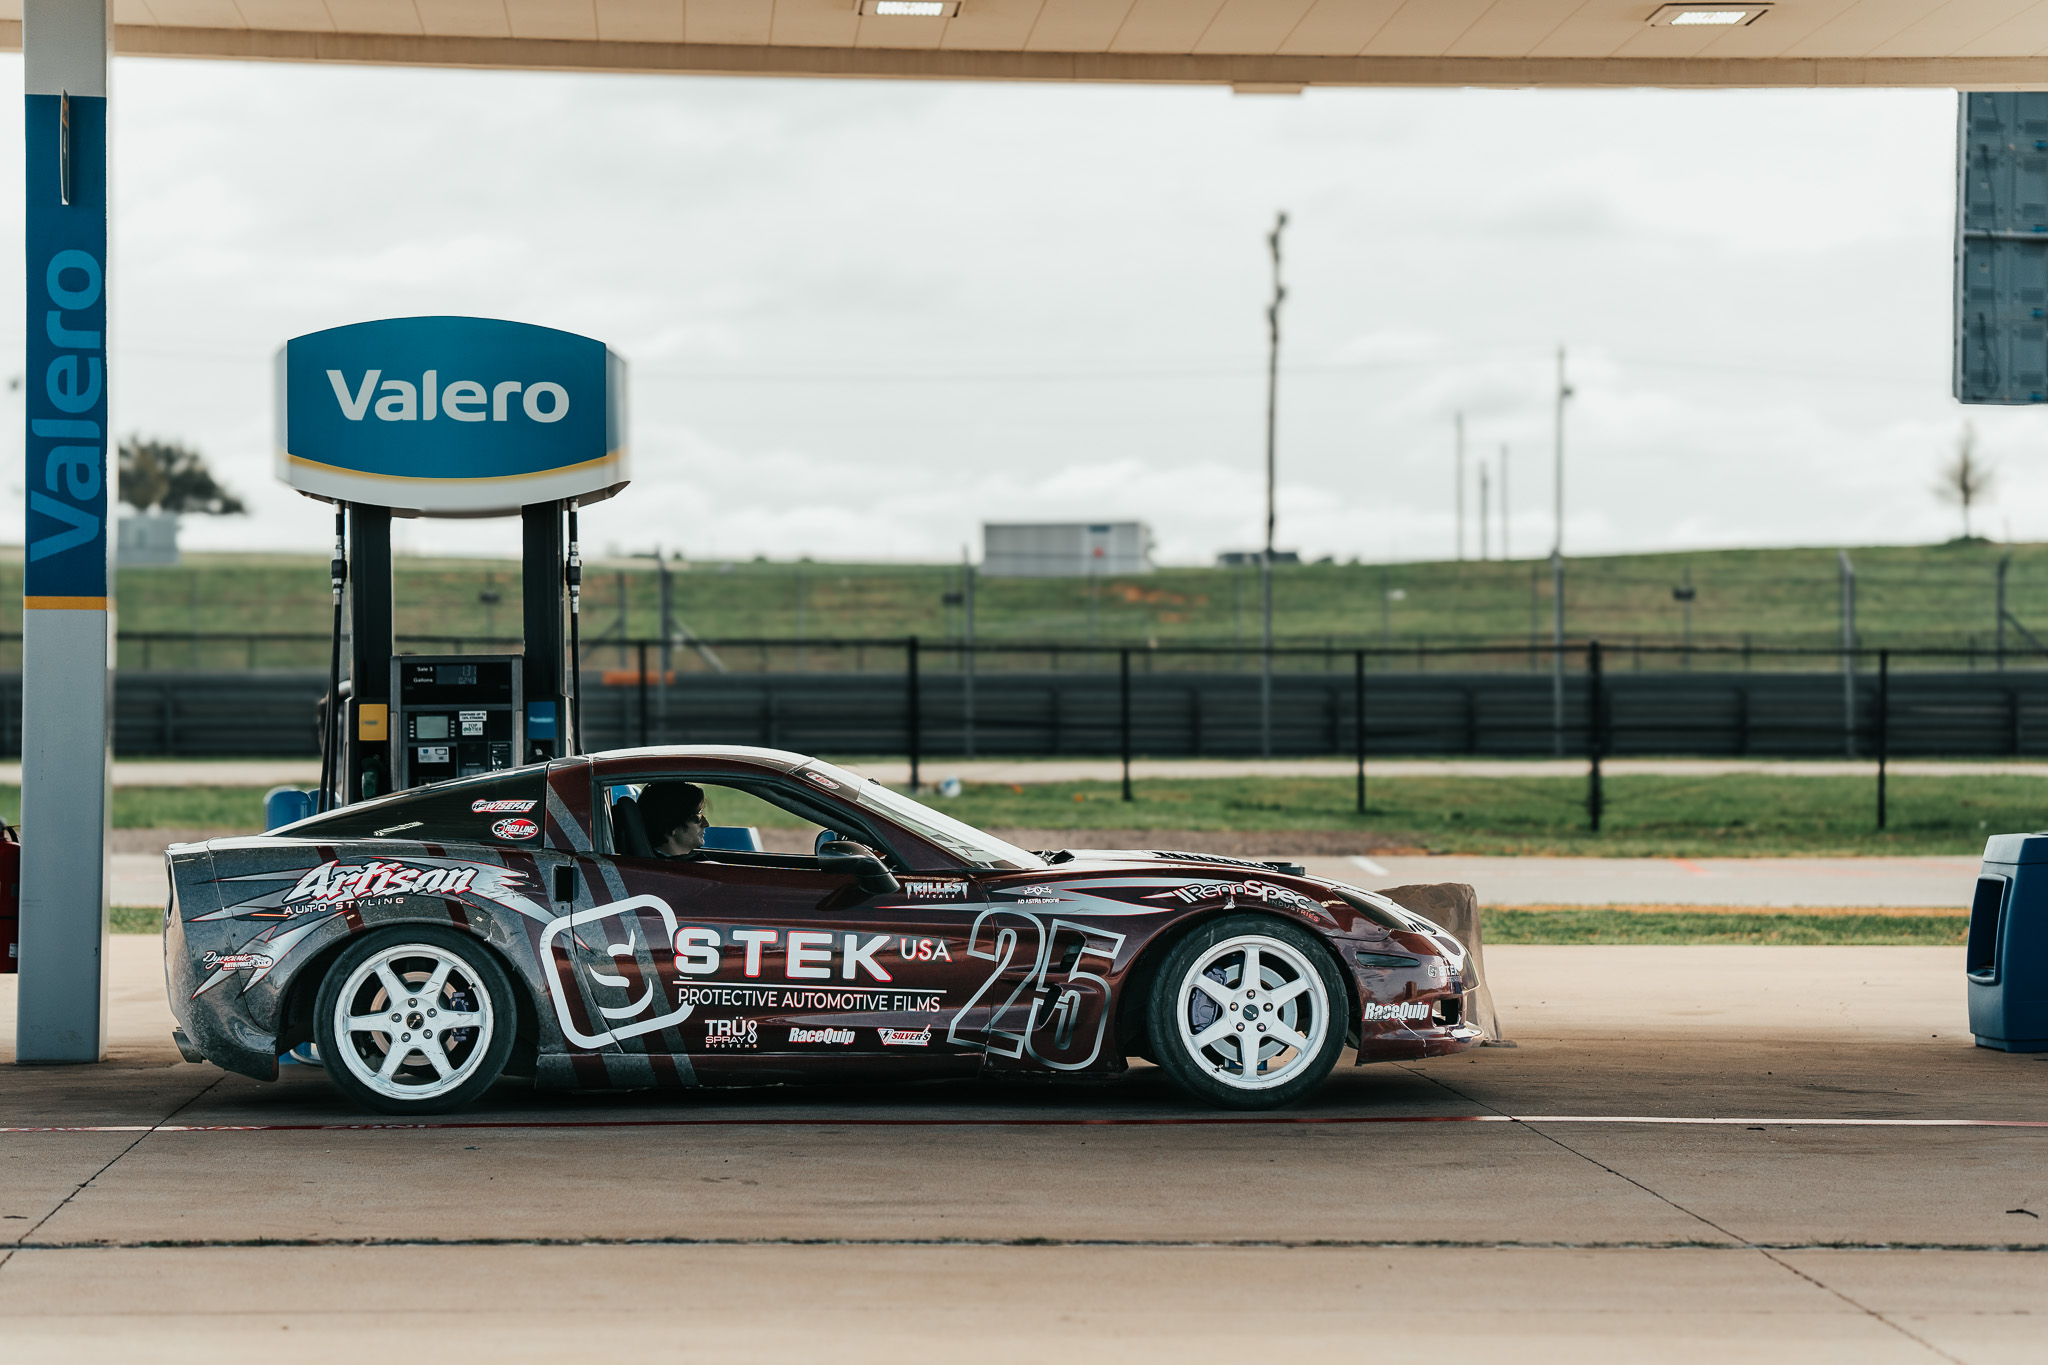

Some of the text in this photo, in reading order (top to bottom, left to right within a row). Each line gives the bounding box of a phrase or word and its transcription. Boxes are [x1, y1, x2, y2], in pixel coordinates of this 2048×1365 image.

[31, 248, 101, 562] Valero
[326, 369, 570, 423] Valero
[486, 801, 536, 811] WISEFAB
[505, 824, 536, 833] RED LINE
[283, 860, 479, 901] Artisan
[905, 882, 969, 899] TRILLEST
[1176, 880, 1314, 911] RennSpec
[284, 903, 327, 915] AUTO
[1268, 899, 1321, 923] INDUSTRIES
[203, 950, 252, 970] Dynamic
[674, 926, 953, 983] STEK USA
[946, 907, 1127, 1071] 25
[678, 988, 941, 1012] PROTECTIVE AUTOMOTIVE FILMS
[1364, 1002, 1430, 1022] RaceQuip
[704, 1016, 747, 1036] TRÜ
[788, 1027, 856, 1045] RaceQuip
[891, 1030, 932, 1041] SILVER'S
[705, 1036, 747, 1044] SPRAY
